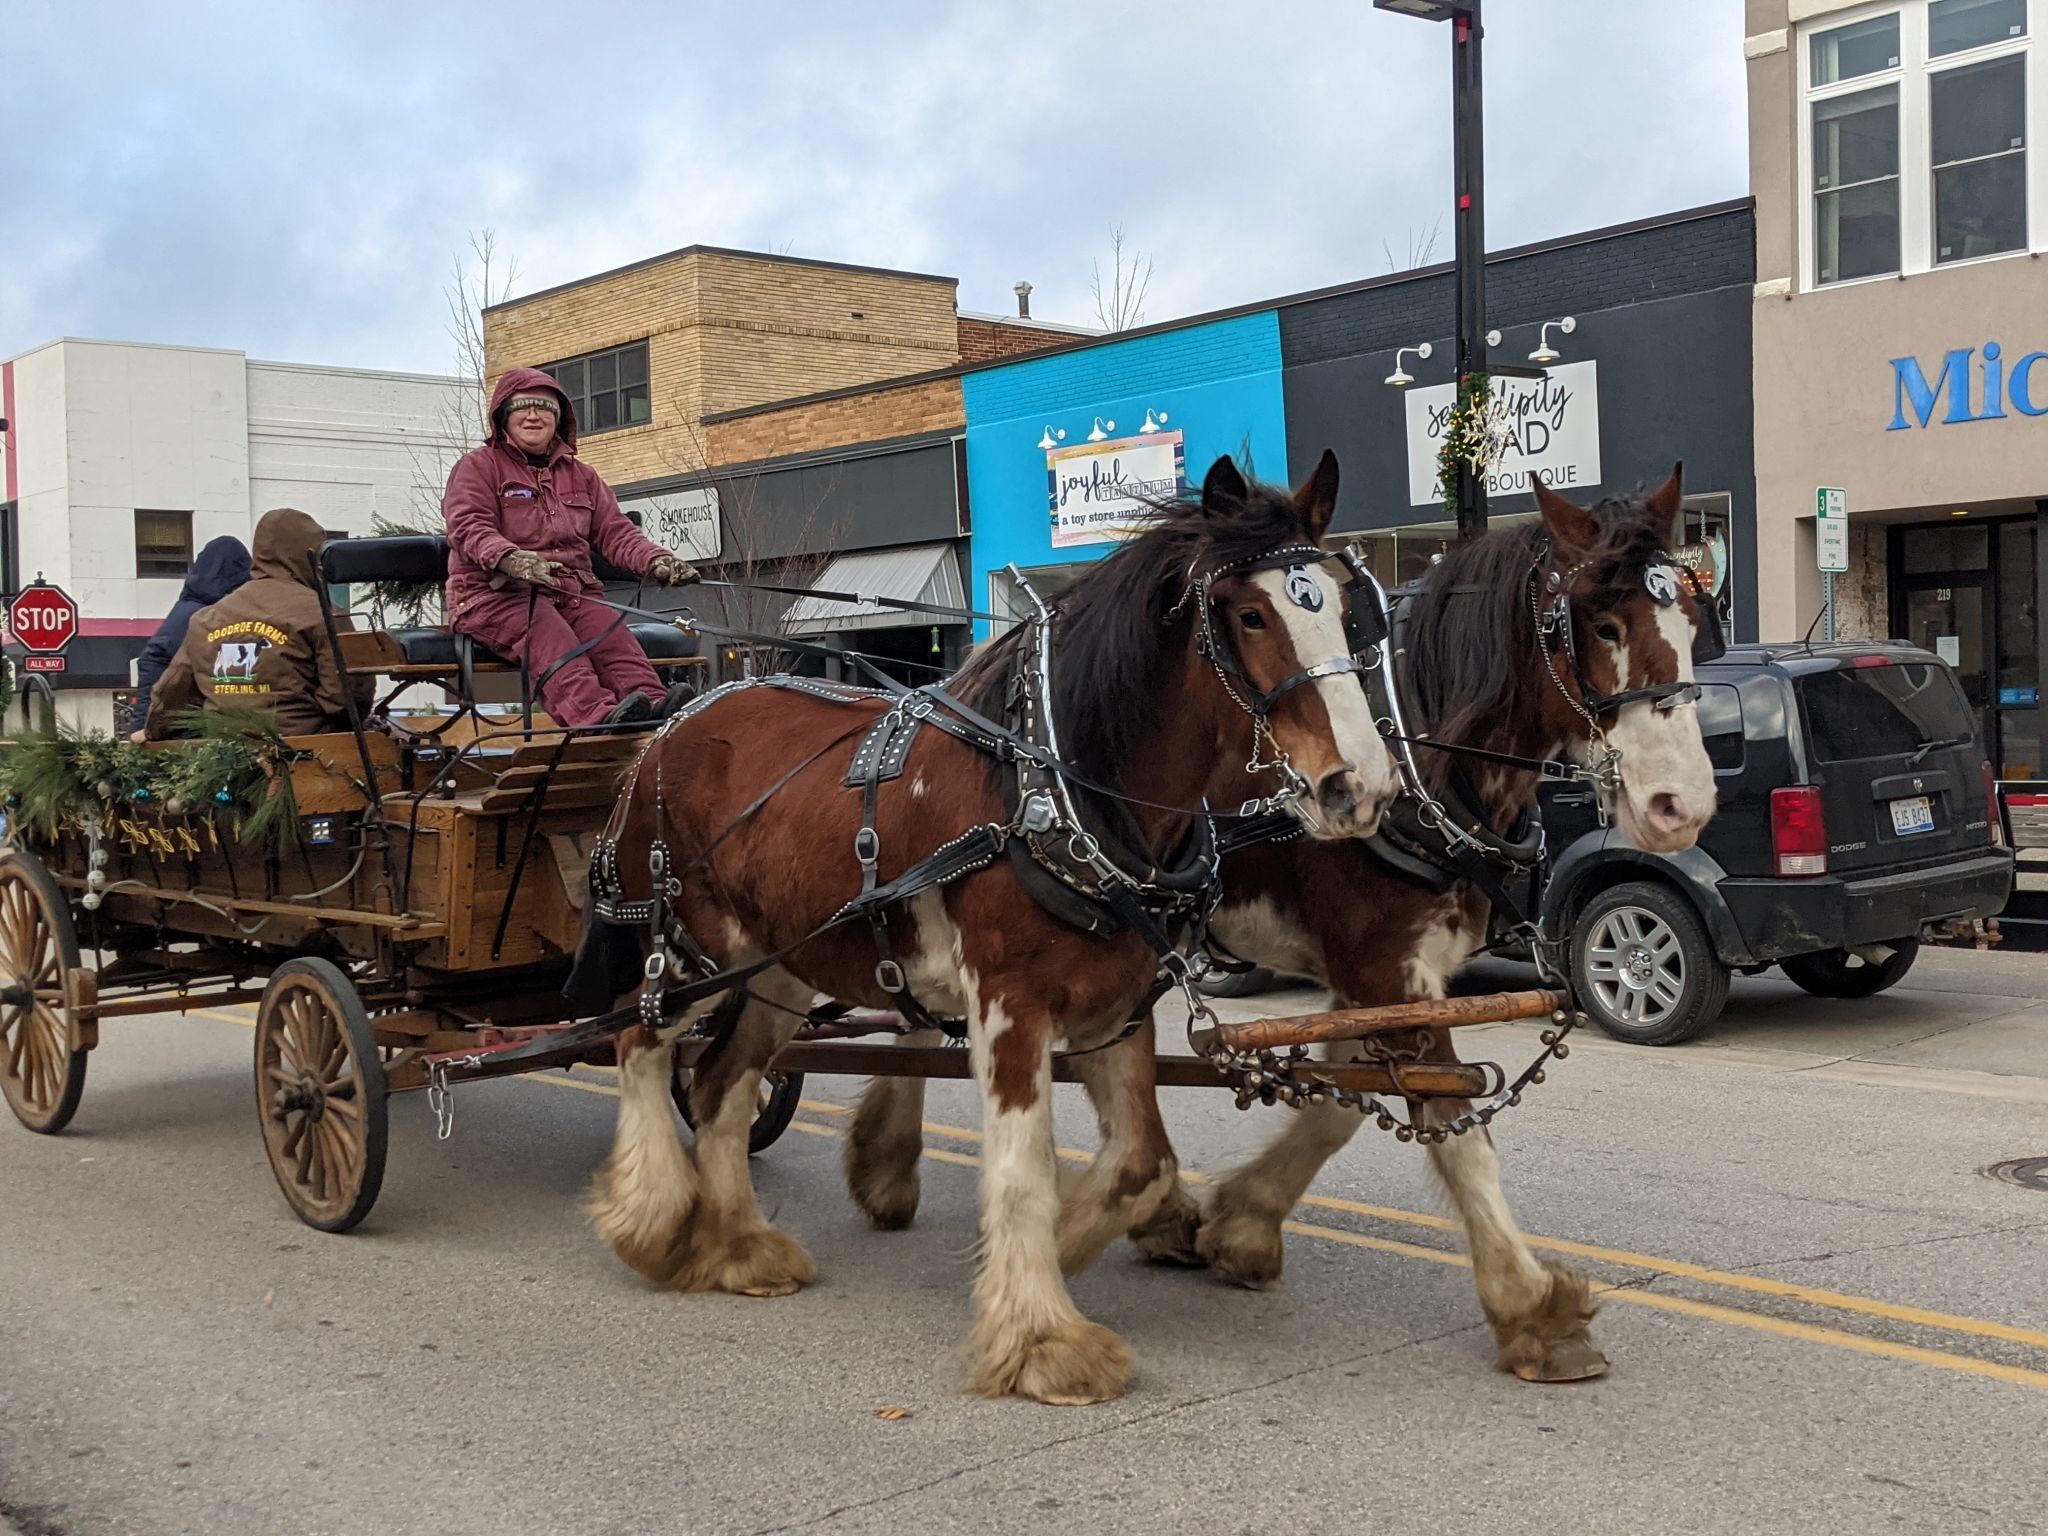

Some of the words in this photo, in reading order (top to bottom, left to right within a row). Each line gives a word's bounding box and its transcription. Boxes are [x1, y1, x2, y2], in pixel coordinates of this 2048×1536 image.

[511, 399, 544, 409] JOHN
[1060, 458, 1128, 506] joyful
[1489, 465, 1577, 492] BOUTQUE
[1101, 478, 1174, 501] TANTRUM
[1819, 495, 1826, 512] 3
[659, 504, 712, 533] SMOKEHOUSE
[1062, 516, 1069, 526] a
[1071, 511, 1086, 525] toy
[1089, 510, 1115, 523] store
[1937, 588, 1951, 600] 219
[16, 607, 70, 631] STOP
[208, 622, 253, 642] GOODROE
[253, 622, 288, 645] FARMS
[30, 660, 43, 668] ALL
[45, 660, 60, 668] WAY
[259, 684, 271, 694] MI
[1895, 809, 1910, 828] EJS
[1912, 806, 1930, 825] 8437
[1831, 841, 1868, 853] DODGE
